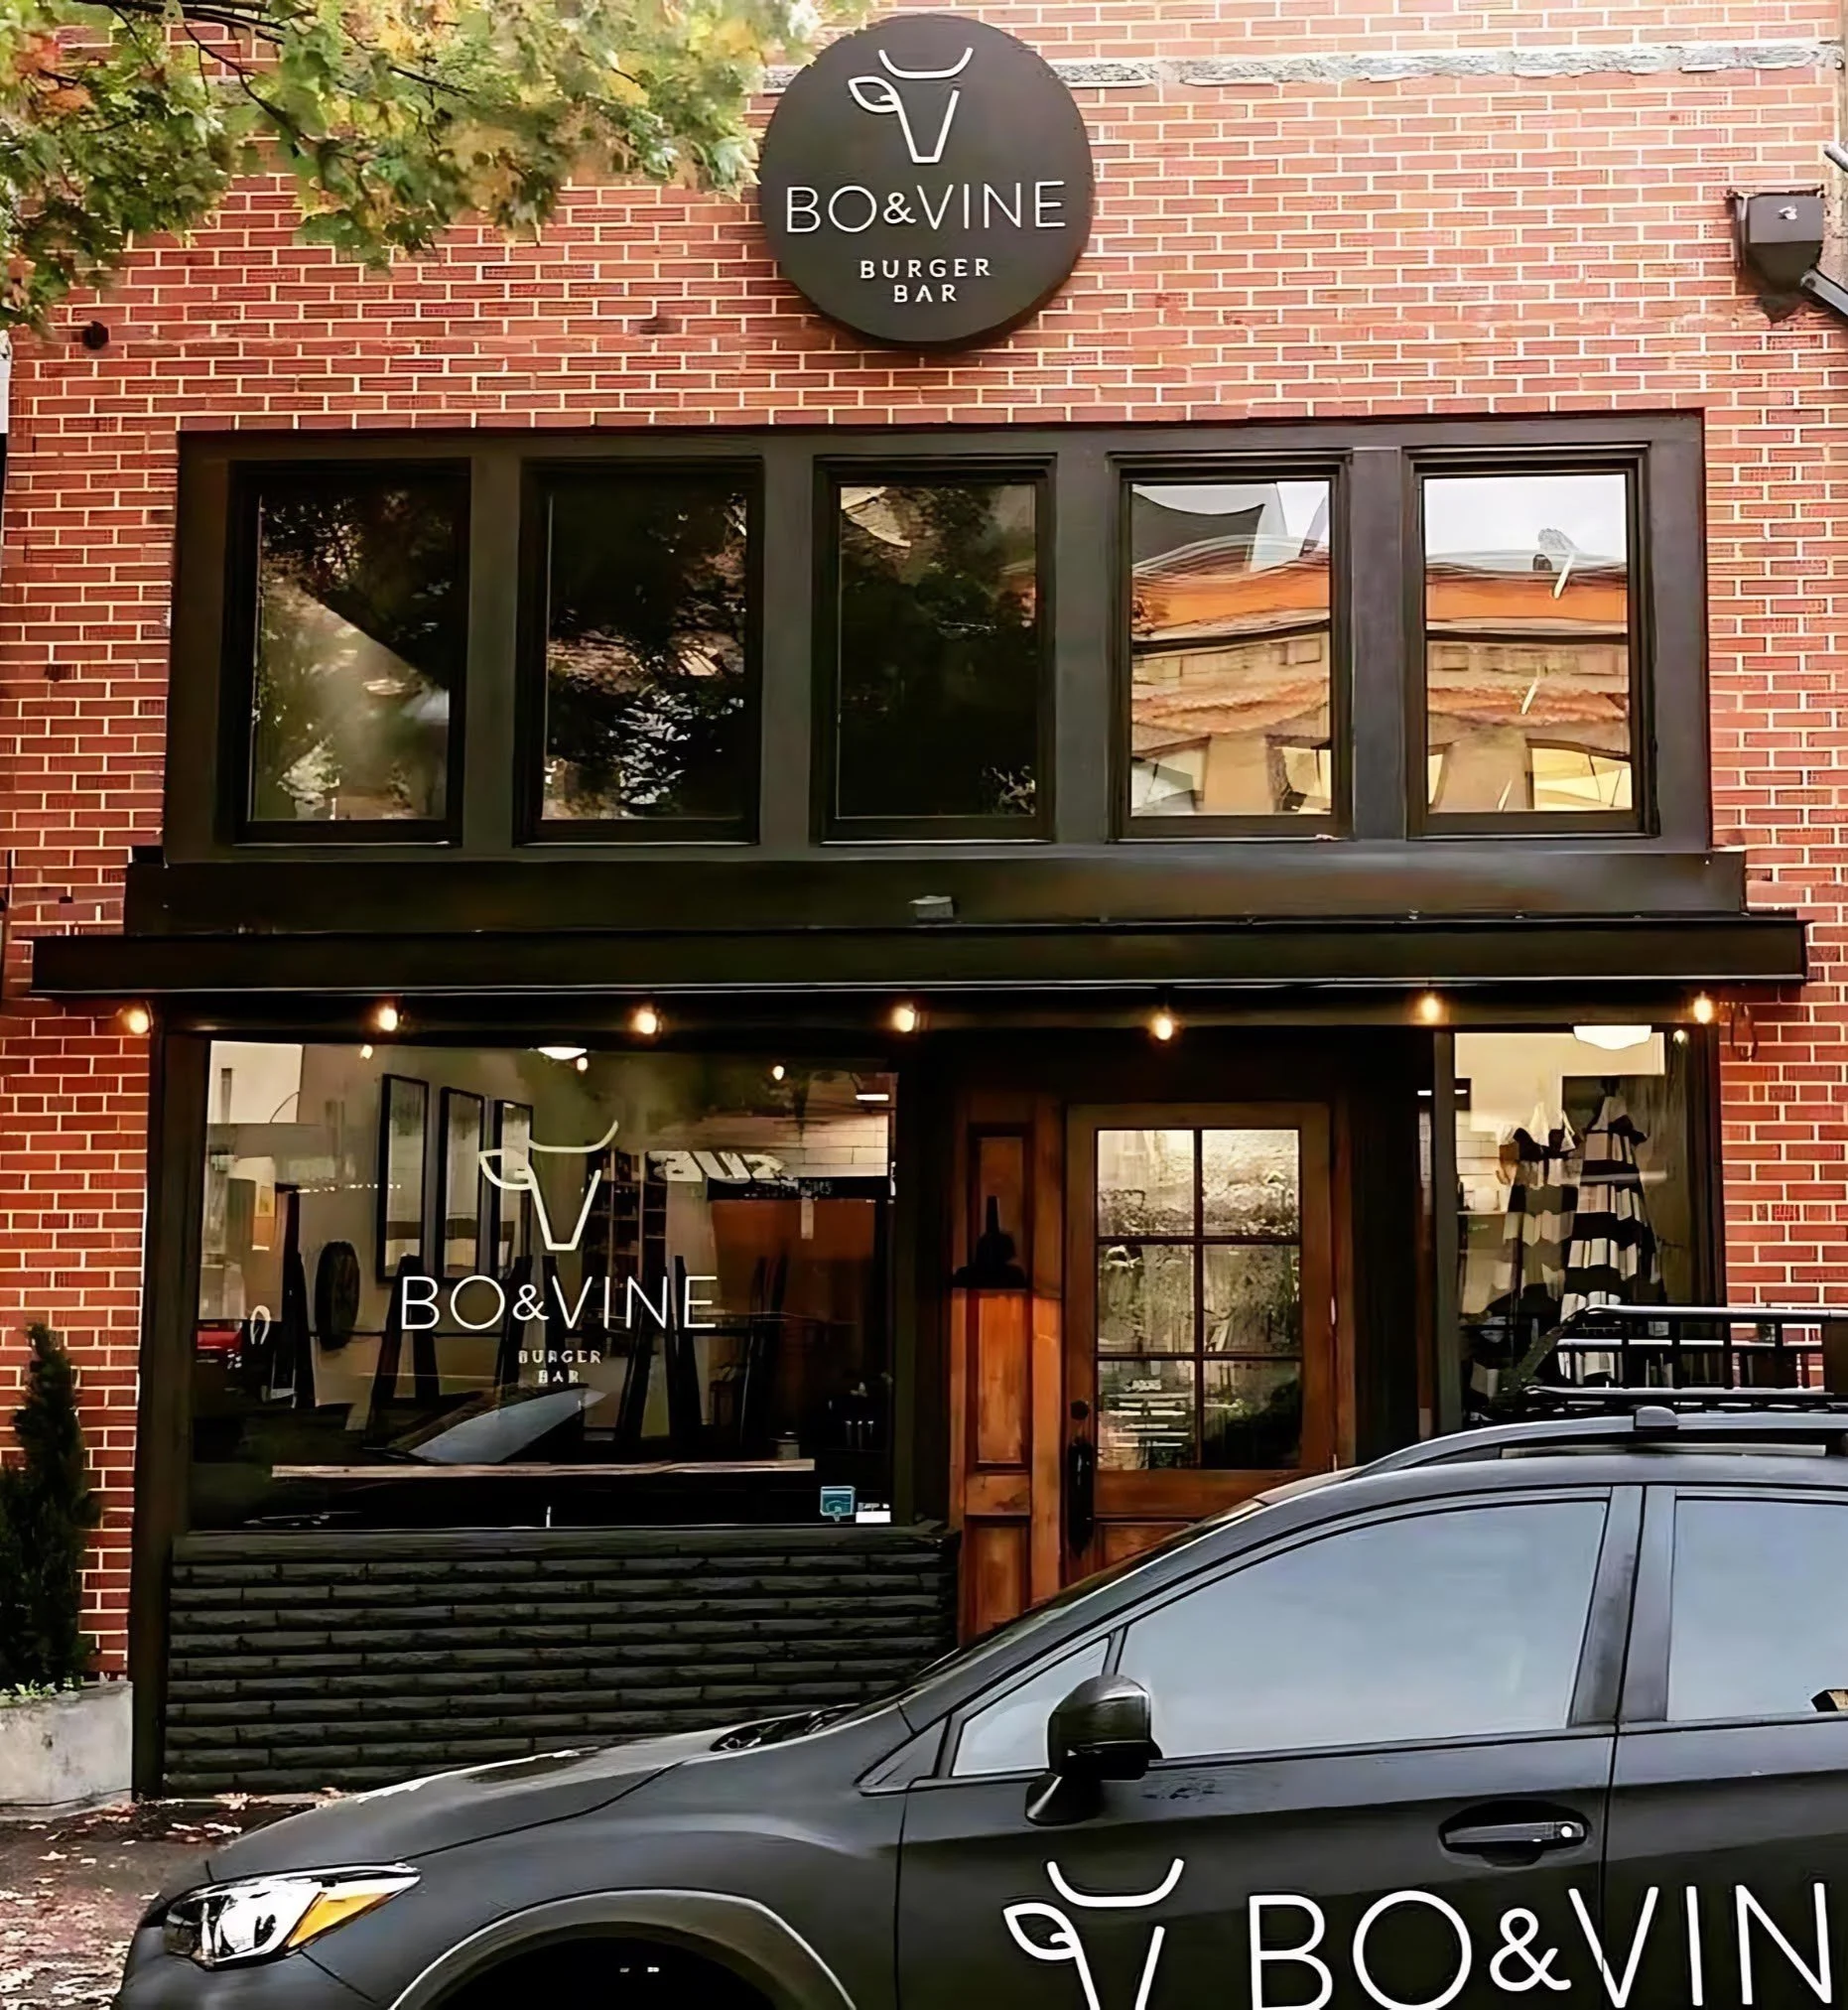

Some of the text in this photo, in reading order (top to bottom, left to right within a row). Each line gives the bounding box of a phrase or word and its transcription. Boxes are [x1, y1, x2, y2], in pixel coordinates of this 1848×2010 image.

[785, 180, 1067, 234] BO&VINE
[859, 258, 991, 280] BURGER
[893, 284, 958, 304] BAR
[401, 1274, 718, 1331] BO&VINE
[517, 1349, 602, 1365] BURGER
[537, 1369, 580, 1385] BAR
[1248, 1882, 1833, 2010] BO&VIN
